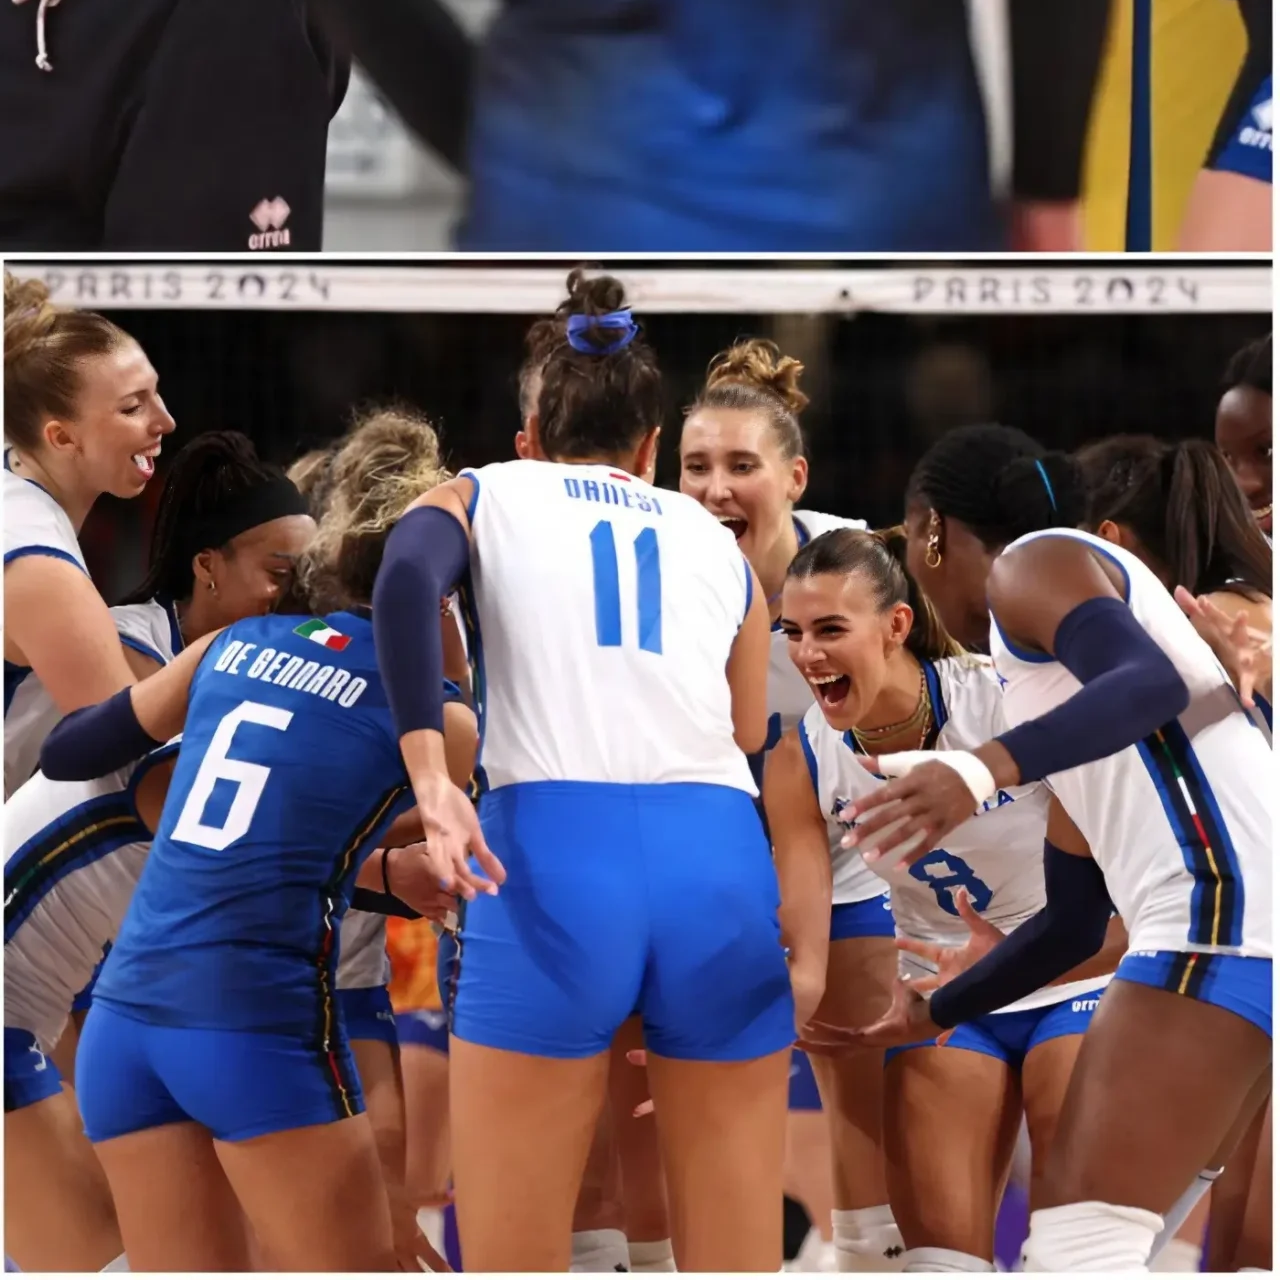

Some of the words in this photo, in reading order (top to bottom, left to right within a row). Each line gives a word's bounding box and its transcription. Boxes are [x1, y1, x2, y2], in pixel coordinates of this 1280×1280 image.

[45, 272, 181, 301] PARIS
[205, 272, 329, 301] 2024
[912, 276, 1051, 304] PARIS
[1073, 276, 1199, 304] 2024
[563, 478, 663, 516] DANESI
[589, 520, 663, 655] 11
[214, 640, 257, 675] DE
[247, 648, 368, 708] GENNARO
[170, 700, 294, 852] 6
[908, 848, 993, 917] 8
